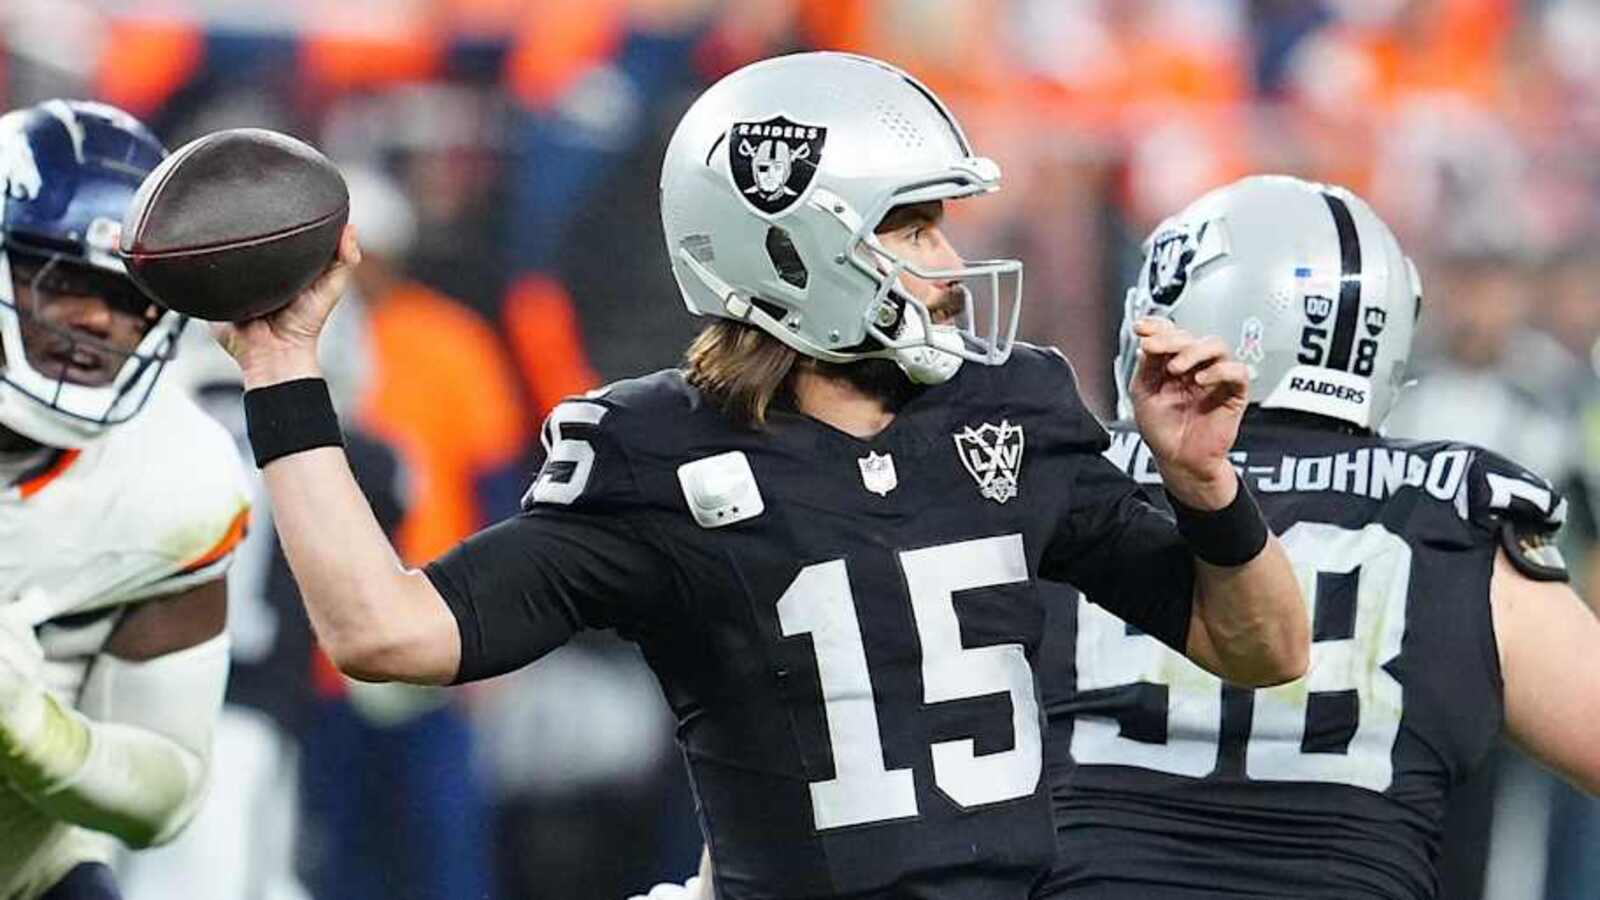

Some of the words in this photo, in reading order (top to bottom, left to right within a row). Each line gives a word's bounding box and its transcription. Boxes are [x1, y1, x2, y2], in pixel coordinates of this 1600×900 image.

[739, 124, 818, 139] RAIDERS
[1297, 327, 1327, 366] 5
[1353, 339, 1378, 378] 8
[1289, 377, 1366, 404] RAIDERS
[777, 533, 1043, 830] 15
